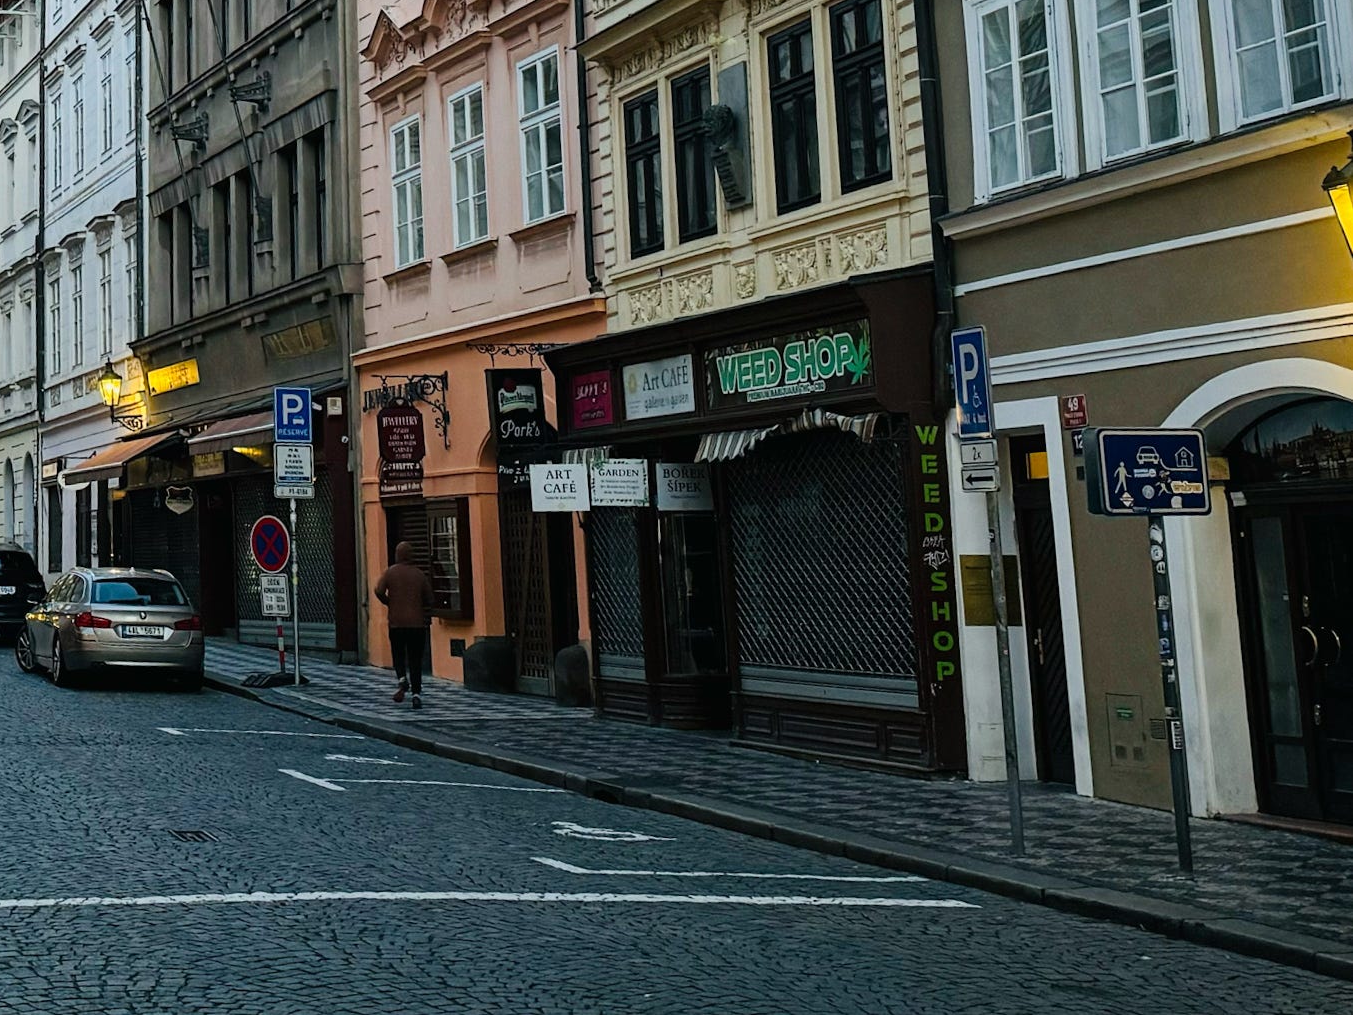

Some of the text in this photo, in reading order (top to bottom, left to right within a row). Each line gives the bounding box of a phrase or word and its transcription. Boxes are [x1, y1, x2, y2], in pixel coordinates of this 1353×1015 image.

[716, 332, 854, 394] WEED SHOP
[642, 358, 689, 392] Art CAFÉ
[959, 343, 979, 404] P
[282, 393, 304, 425] P
[1067, 397, 1079, 411] 49
[500, 419, 541, 439] Pork's
[546, 469, 573, 480] ART
[598, 468, 640, 478] GARDEN
[663, 467, 705, 479] BOŘEK
[915, 425, 944, 533] WEED
[543, 480, 577, 494] CAFÉ
[667, 479, 703, 493] ŠÍPEK
[930, 571, 955, 682] SHOP
